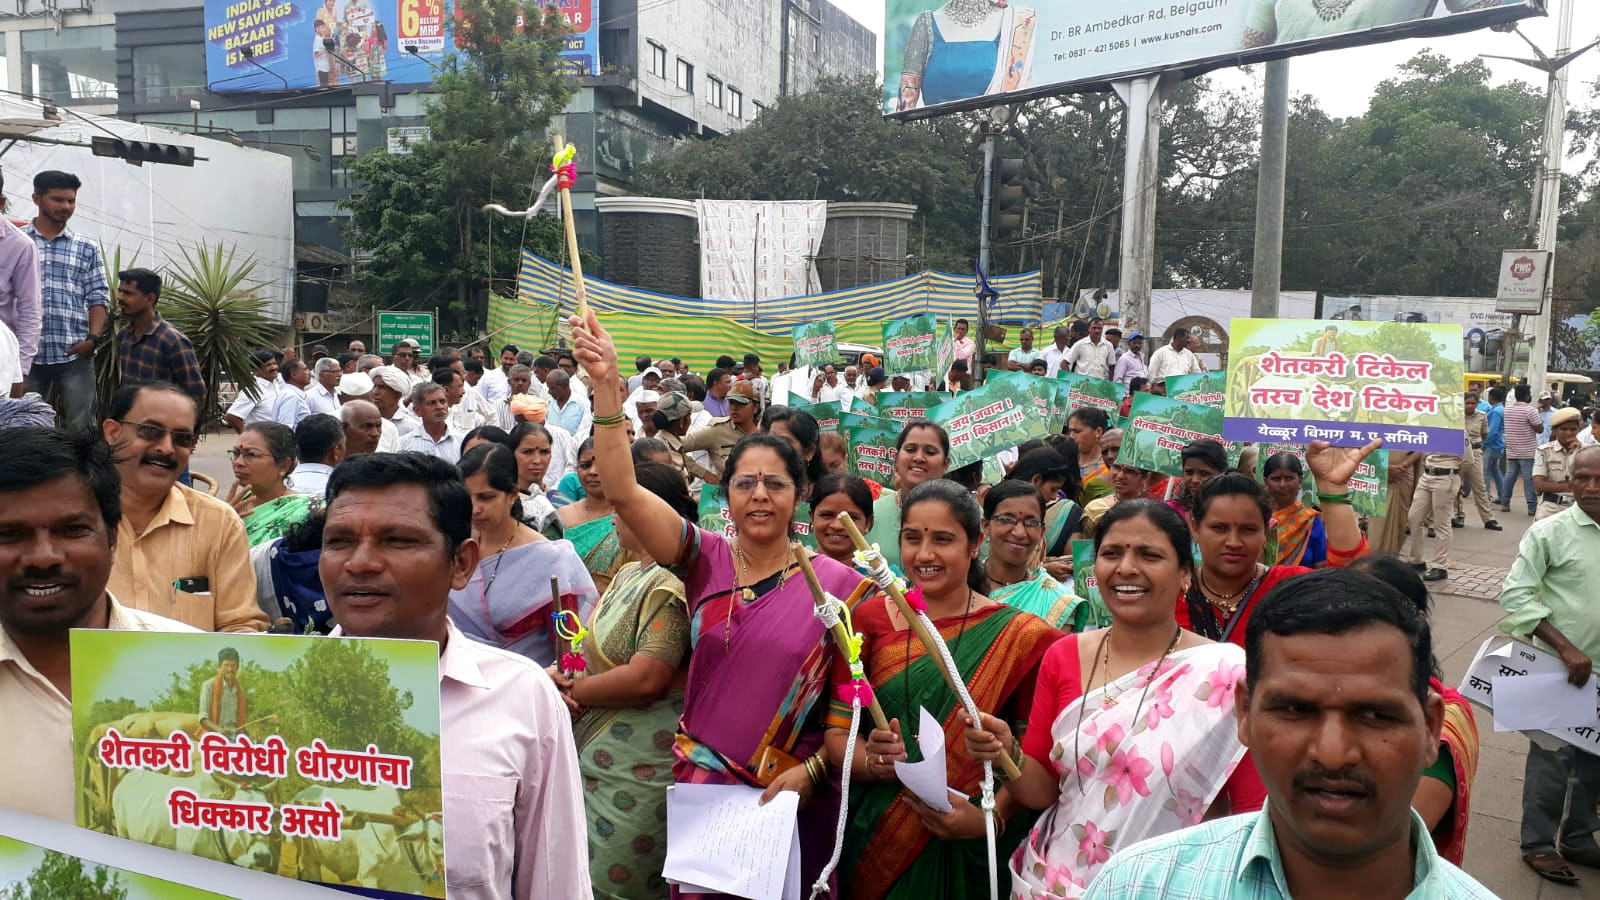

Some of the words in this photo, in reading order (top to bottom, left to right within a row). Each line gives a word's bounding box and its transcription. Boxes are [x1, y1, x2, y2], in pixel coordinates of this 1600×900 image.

[208, 21, 236, 40] NEW
[238, 2, 292, 30] SAVINGS
[420, 17, 439, 25] BELOW
[420, 25, 440, 36] MRP
[516, 12, 583, 27] BZAR
[1051, 31, 1065, 41] Dr.
[1068, 26, 1082, 38] BR
[1084, 13, 1145, 35] Ambedkar
[1148, 8, 1167, 21] Rd,
[1170, 0, 1228, 17] Belgaum
[225, 24, 275, 50] BAZAAR
[568, 40, 584, 49] OCT
[1053, 51, 1067, 62] Tel:
[1068, 47, 1086, 59] 0831
[1109, 39, 1130, 51] 5065
[1140, 23, 1222, 45] www.kushals.com
[226, 52, 237, 66] IS
[1513, 263, 1532, 273] PNG
[1261, 352, 1346, 376] शेतकरी
[1356, 355, 1430, 379] टिकेल
[1251, 387, 1303, 405] तरच
[1312, 384, 1354, 410] देश
[1363, 387, 1438, 413] टिकेल
[951, 416, 969, 429] जय
[973, 402, 1003, 420] जवान
[951, 432, 969, 446] जय
[972, 416, 1010, 437] किसान
[1013, 412, 1023, 421] !!
[1304, 425, 1345, 440] विभाग
[1349, 430, 1365, 441] म.
[1384, 431, 1428, 445] समिती
[858, 444, 886, 457] शेतकरी
[858, 461, 874, 470] तरच
[878, 462, 890, 473] देश
[100, 730, 191, 770] शेतकरी
[201, 734, 287, 775] विरोधी
[298, 742, 410, 786] धोरणांचा
[169, 790, 270, 830] धिक्कार
[281, 801, 341, 837] असो
